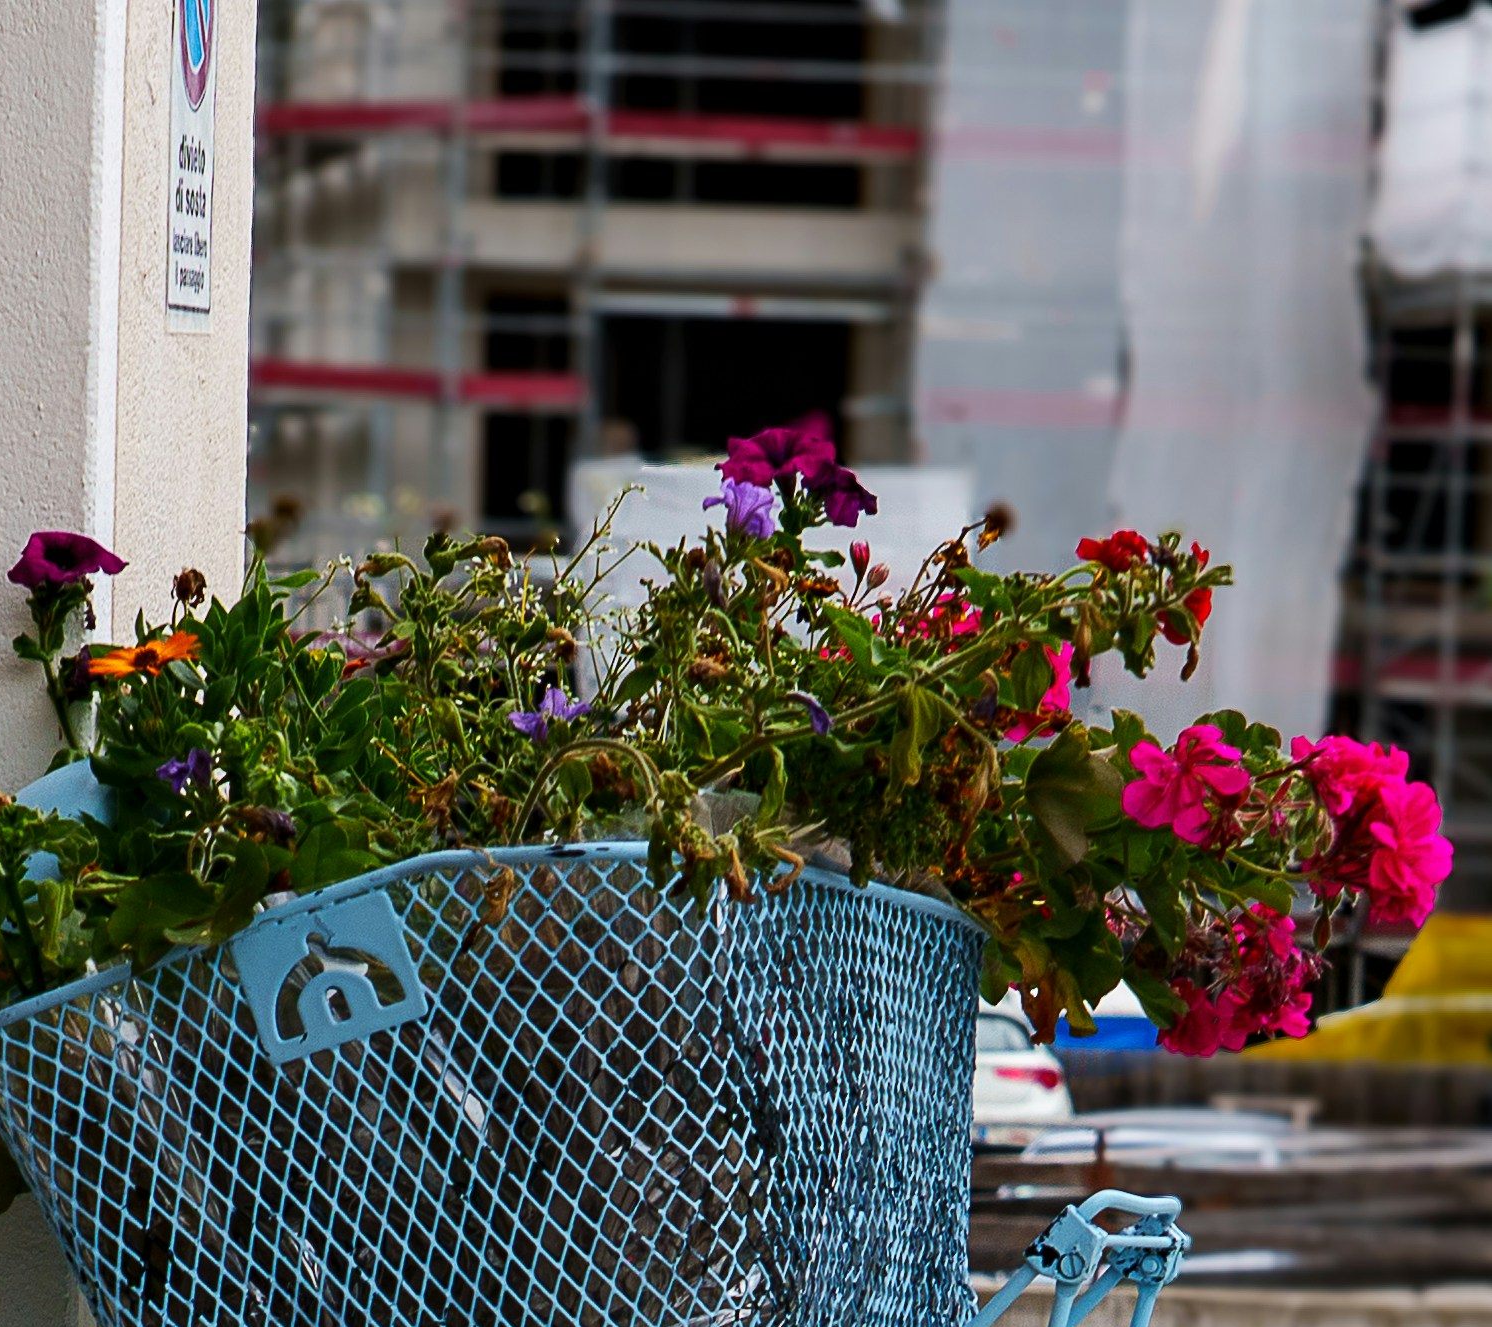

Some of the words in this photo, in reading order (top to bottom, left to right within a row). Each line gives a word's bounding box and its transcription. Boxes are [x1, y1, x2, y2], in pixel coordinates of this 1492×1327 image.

[179, 134, 206, 176] divieto
[176, 178, 183, 213] di
[186, 184, 206, 219] sosta
[173, 227, 193, 256] lasciare
